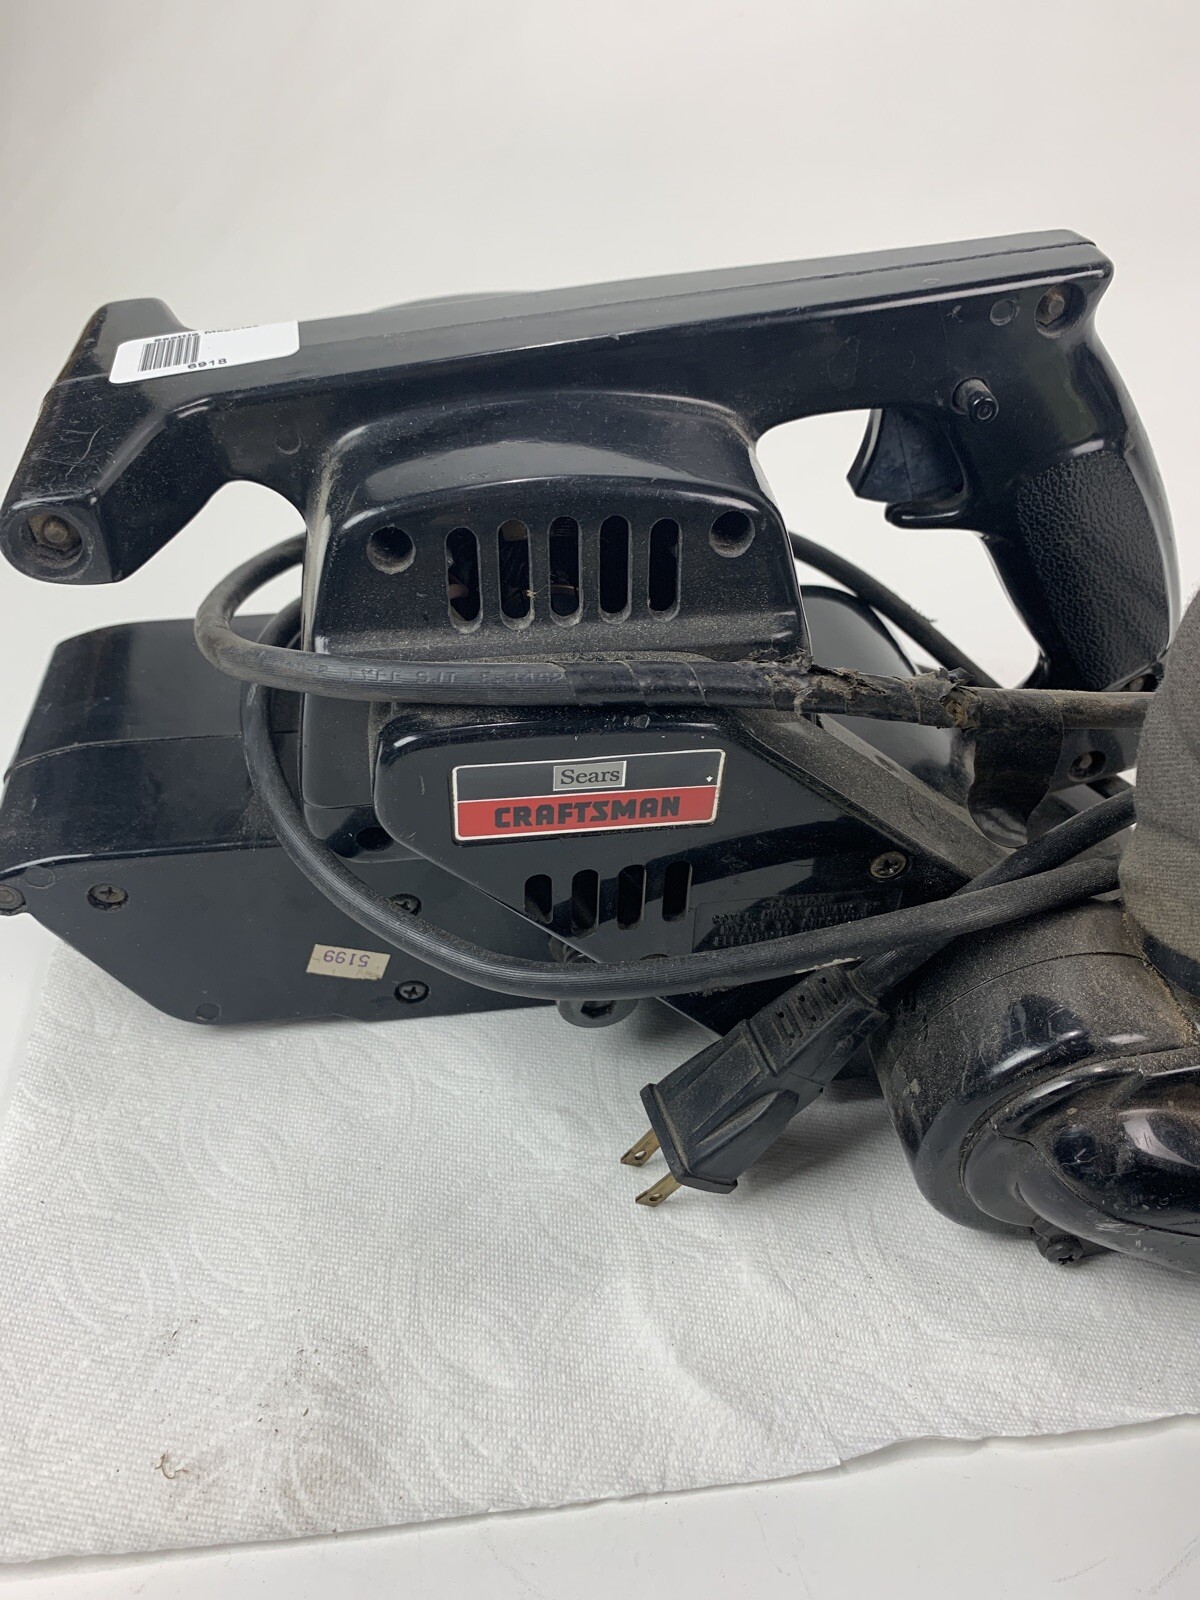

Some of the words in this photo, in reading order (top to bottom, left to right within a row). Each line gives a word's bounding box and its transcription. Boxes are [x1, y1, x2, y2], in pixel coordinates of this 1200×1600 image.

[187, 358, 228, 370] 6918
[560, 768, 621, 785] Sears
[494, 796, 681, 829] CRAFTSMAN
[323, 949, 371, 968] 5199
